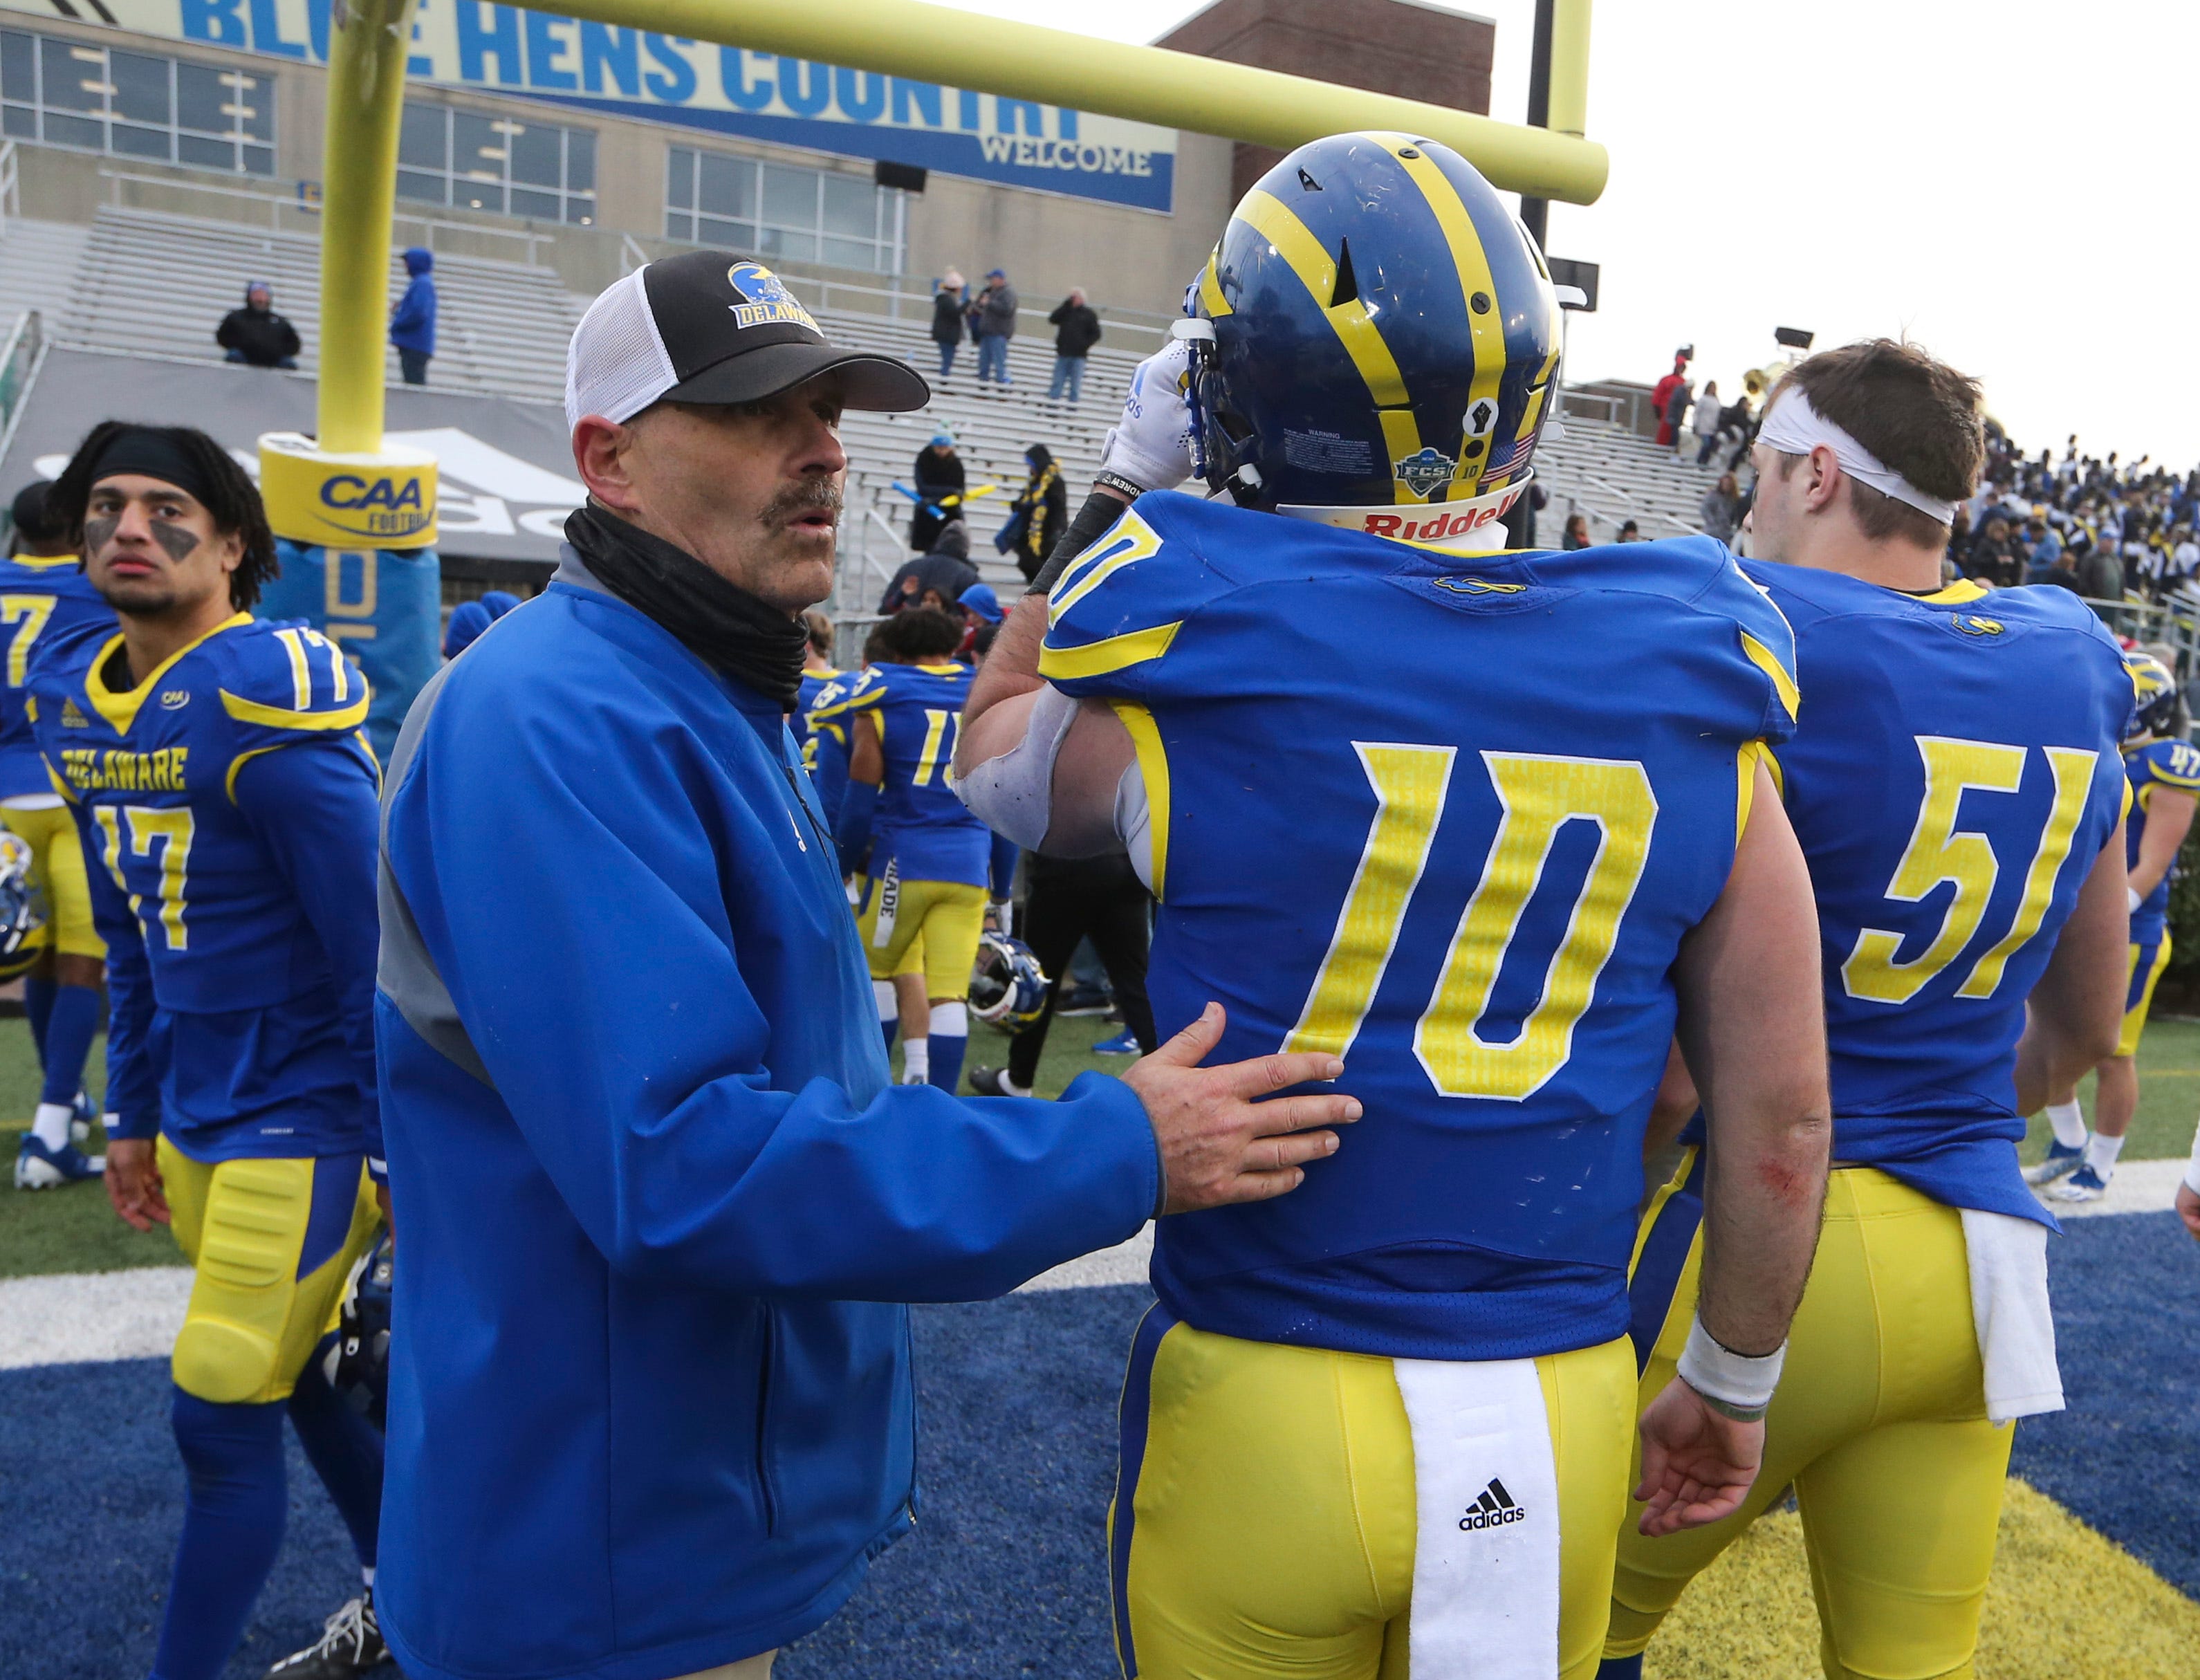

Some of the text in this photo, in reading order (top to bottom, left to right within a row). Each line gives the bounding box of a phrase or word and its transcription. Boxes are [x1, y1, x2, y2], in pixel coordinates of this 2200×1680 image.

[455, 0, 697, 104] HENS
[719, 43, 1079, 139] COUN
[978, 134, 1153, 178] WELCOME
[1308, 429, 1340, 440] WARNING
[320, 474, 423, 510] CAA
[1404, 466, 1447, 477] FCS
[1463, 464, 1479, 479] 10
[368, 512, 427, 532] FOOTB
[1365, 488, 1522, 539] Riddell
[272, 626, 348, 712] 17
[93, 805, 196, 951] 17
[1840, 735, 2100, 1006] 51
[1278, 739, 1660, 1103] 10
[1459, 1507, 1525, 1531] adidas
